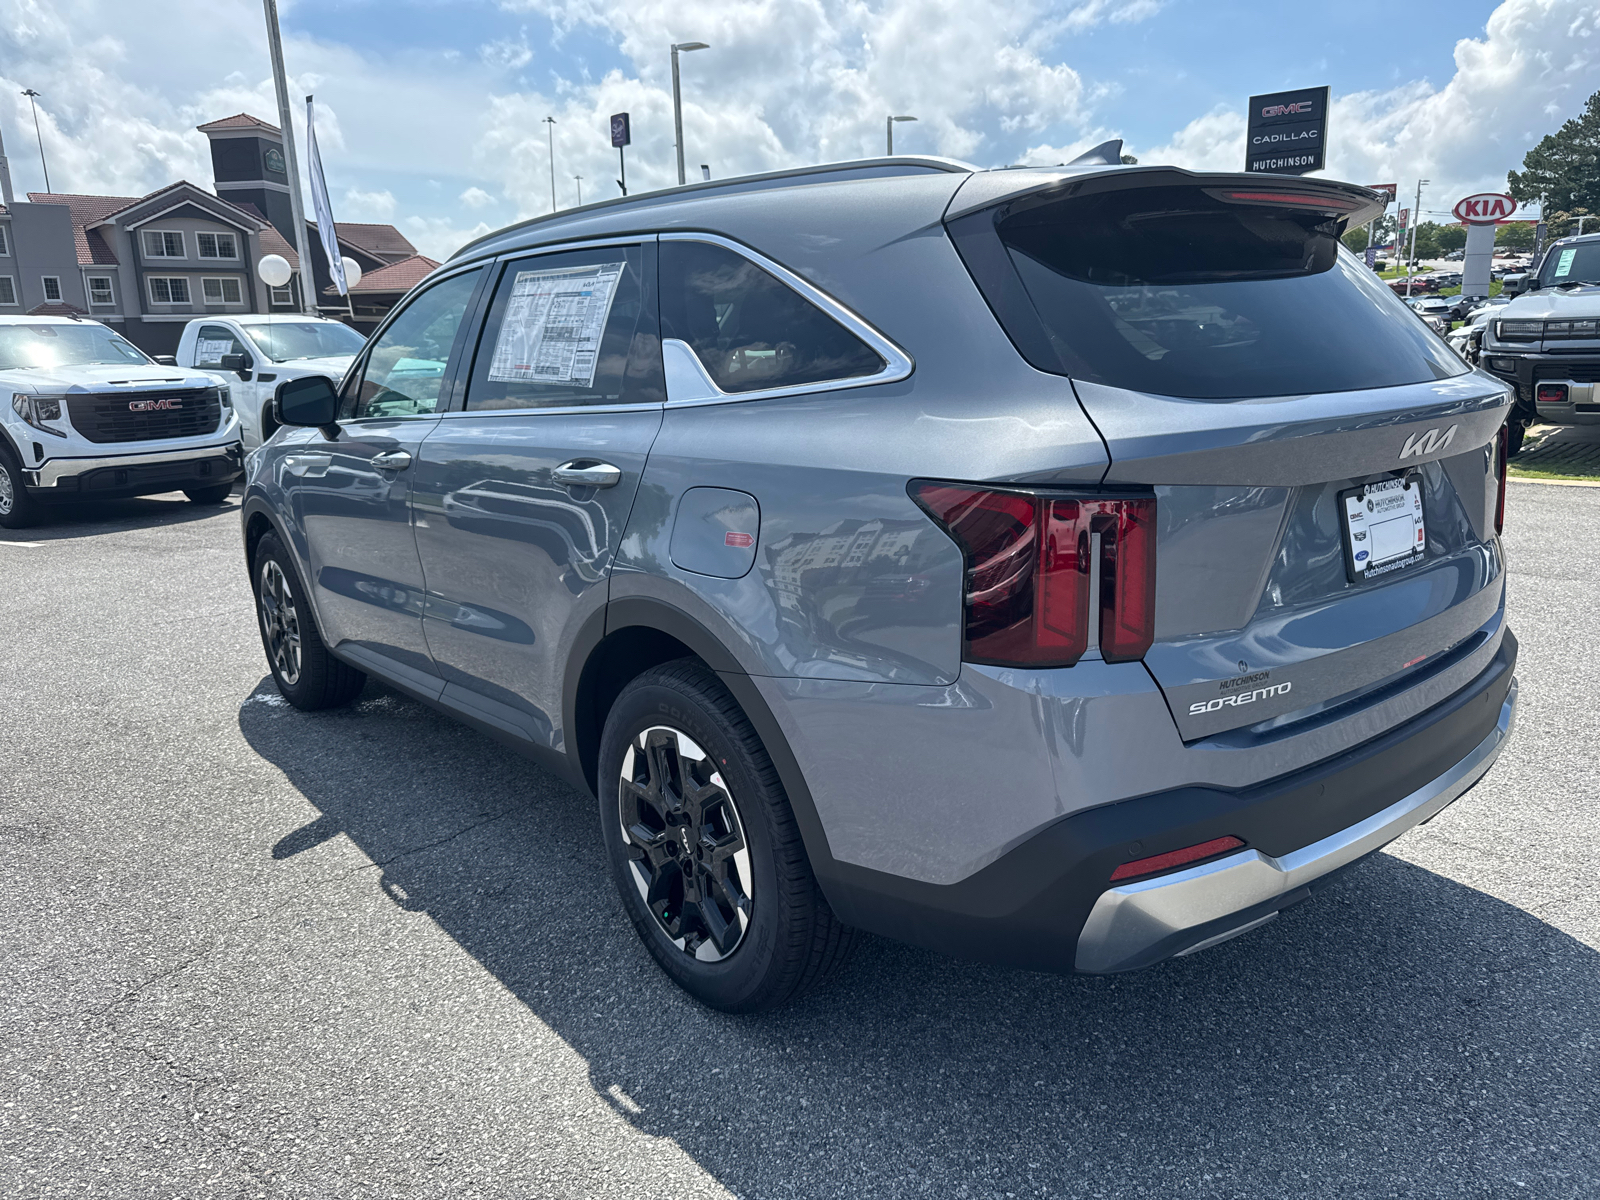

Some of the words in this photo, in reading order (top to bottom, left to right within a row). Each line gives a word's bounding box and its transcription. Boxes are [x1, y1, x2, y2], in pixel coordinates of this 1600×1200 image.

[1262, 101, 1312, 117] GMC
[1253, 130, 1318, 144] CADILLAC
[1253, 155, 1314, 171] HUTCHINSON
[1465, 199, 1506, 217] KIA
[129, 398, 183, 412] GMC
[1371, 478, 1405, 494] HUTCHINSON
[1364, 553, 1424, 579] Hutchinsonautogroup.com
[1219, 671, 1271, 690] HUTCHINSON
[1220, 685, 1251, 696] AUTOMOTIVE
[1251, 681, 1268, 689] GROUP
[1188, 681, 1292, 716] SORENTO
